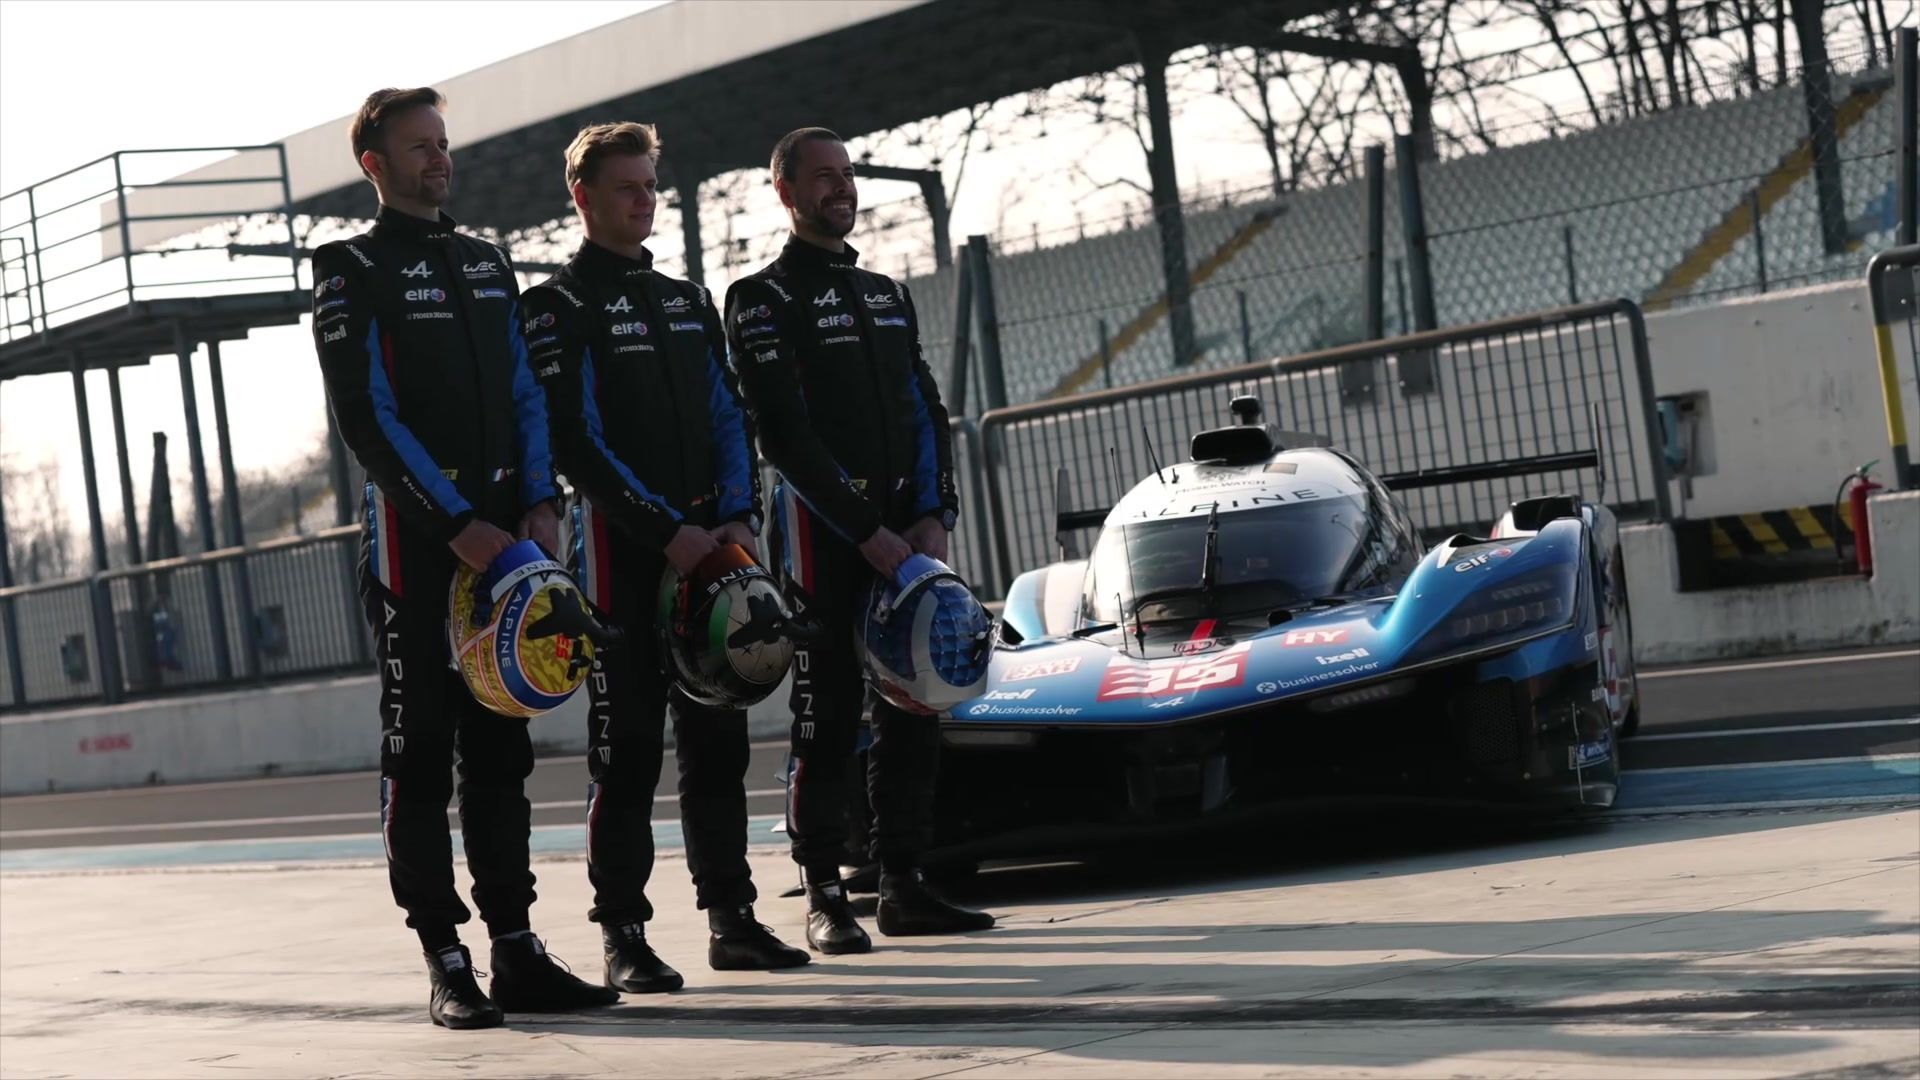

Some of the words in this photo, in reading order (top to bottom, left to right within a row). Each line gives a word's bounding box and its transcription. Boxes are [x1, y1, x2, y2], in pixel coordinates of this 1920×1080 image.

[463, 261, 498, 272] WEC
[405, 288, 430, 301] elf
[611, 323, 634, 335] elf
[817, 315, 840, 328] elf
[324, 324, 347, 343] ixell
[540, 360, 560, 377] xell
[1221, 479, 1267, 488] WATCH
[1133, 488, 1320, 519] ALPINE
[1455, 554, 1489, 572] elf
[501, 591, 522, 668] ALPINE
[1285, 630, 1345, 645] HY
[1315, 648, 1370, 665] ixell
[795, 596, 815, 740] APINE
[1277, 661, 1380, 690] businessolver
[383, 600, 405, 755] ALPINE
[988, 704, 1083, 716] businessolver
